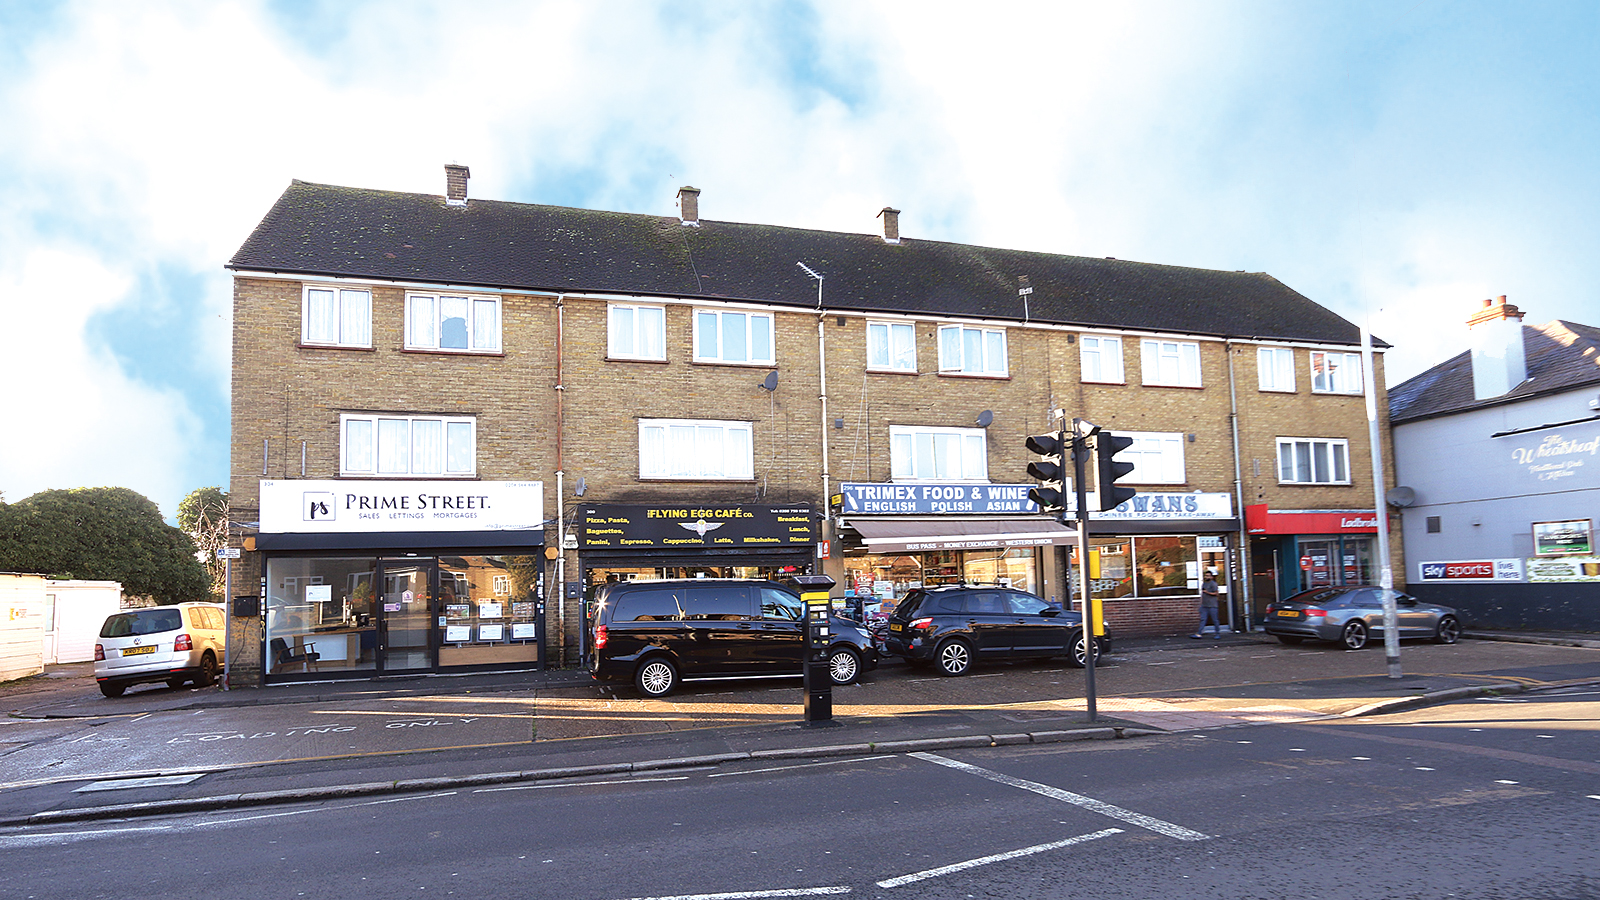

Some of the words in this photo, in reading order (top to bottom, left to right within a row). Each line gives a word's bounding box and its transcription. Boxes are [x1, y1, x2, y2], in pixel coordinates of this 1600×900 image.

[1543, 435, 1563, 448] The
[1512, 436, 1600, 464] Wheatsheaf
[855, 486, 917, 500] TRIMEX
[922, 486, 965, 500] FOOD
[971, 486, 983, 500] &
[988, 486, 1028, 500] WINE
[651, 509, 688, 519] FLYING
[690, 509, 714, 518] EGG
[715, 507, 743, 518] CAFÉ
[864, 502, 917, 512] ENGLISH
[931, 501, 973, 513] POLISH
[987, 501, 1020, 511] ASIAN
[359, 512, 380, 520] SALES
[586, 517, 607, 525] Pizza,
[608, 517, 630, 525] Pasta,
[586, 528, 625, 536] Baguettes,
[620, 538, 654, 546] Espresso,
[1424, 564, 1445, 578] sky
[1447, 563, 1492, 577] sports
[1497, 561, 1514, 570] live
[1498, 570, 1520, 579] here
[166, 726, 357, 744] LOADING
[385, 717, 479, 729] ONLY
